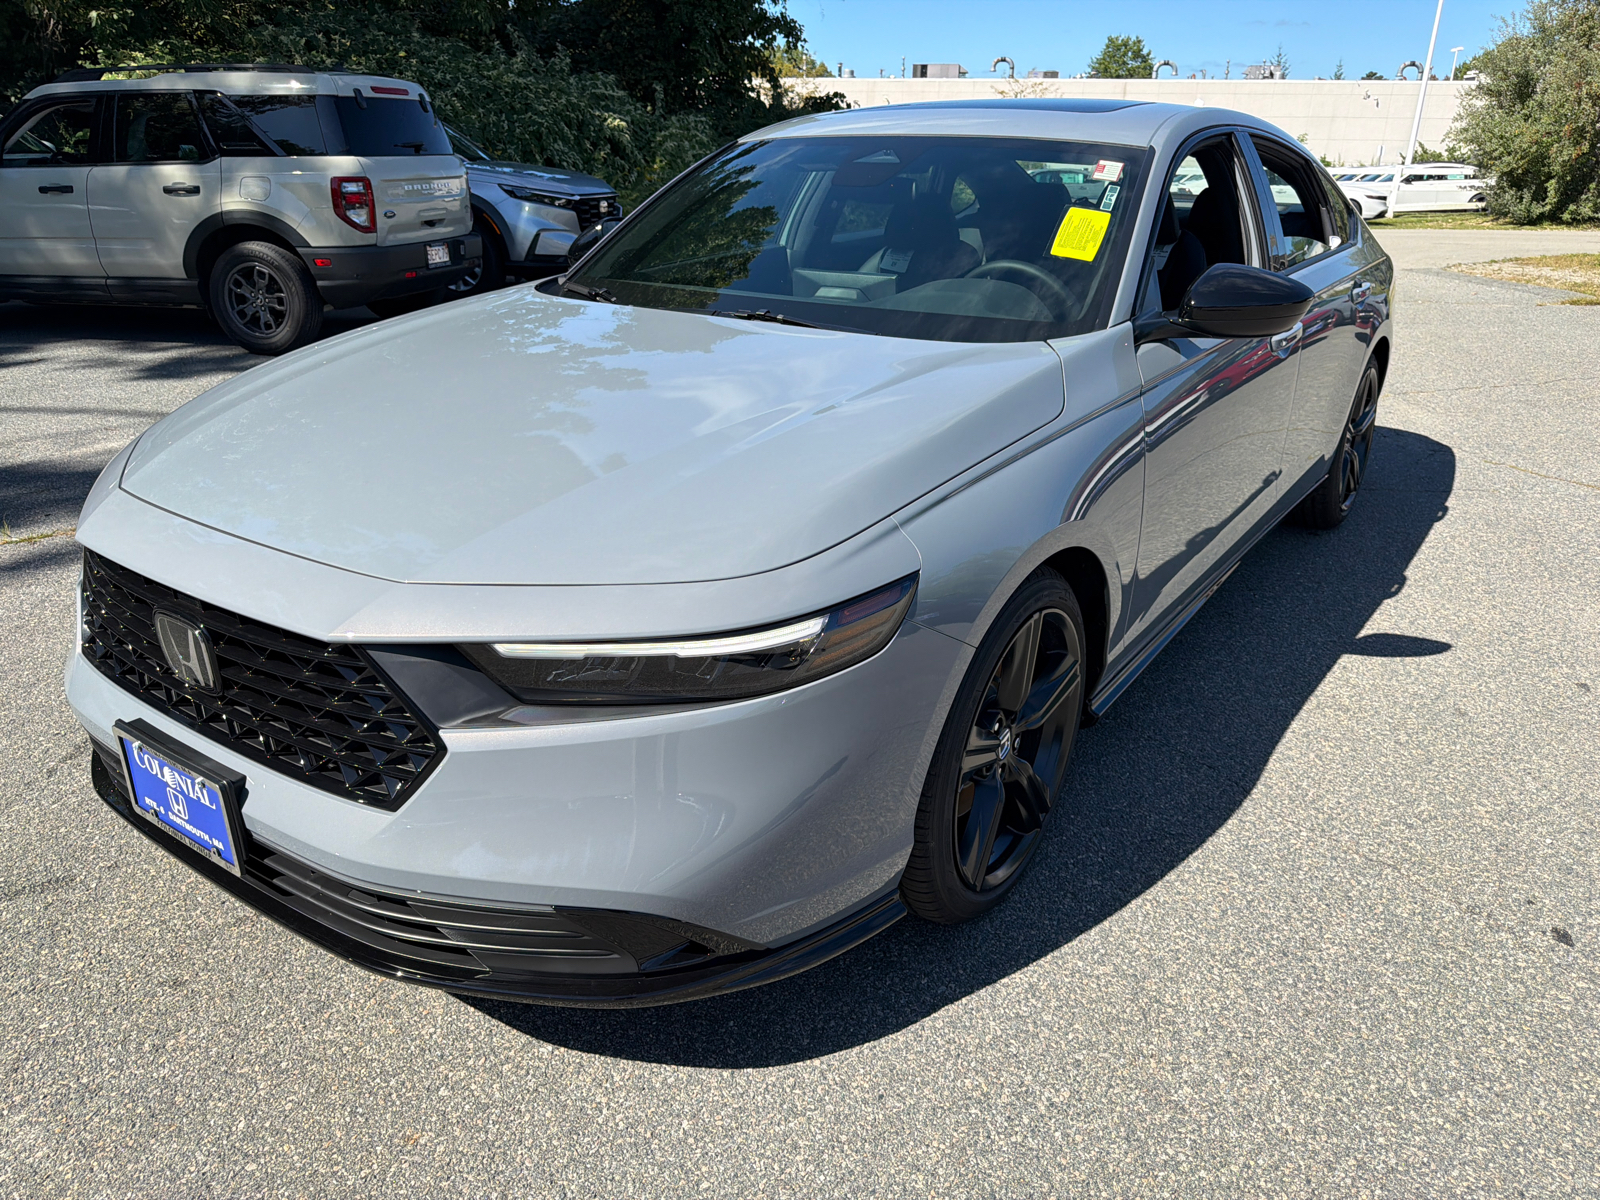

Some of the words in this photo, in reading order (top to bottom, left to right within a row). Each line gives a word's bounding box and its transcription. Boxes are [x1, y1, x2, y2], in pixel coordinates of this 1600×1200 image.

[404, 182, 451, 191] BRONCO
[132, 744, 216, 810] COLONIAL
[168, 810, 212, 845] DARTMOUTH,
[212, 837, 225, 851] MA
